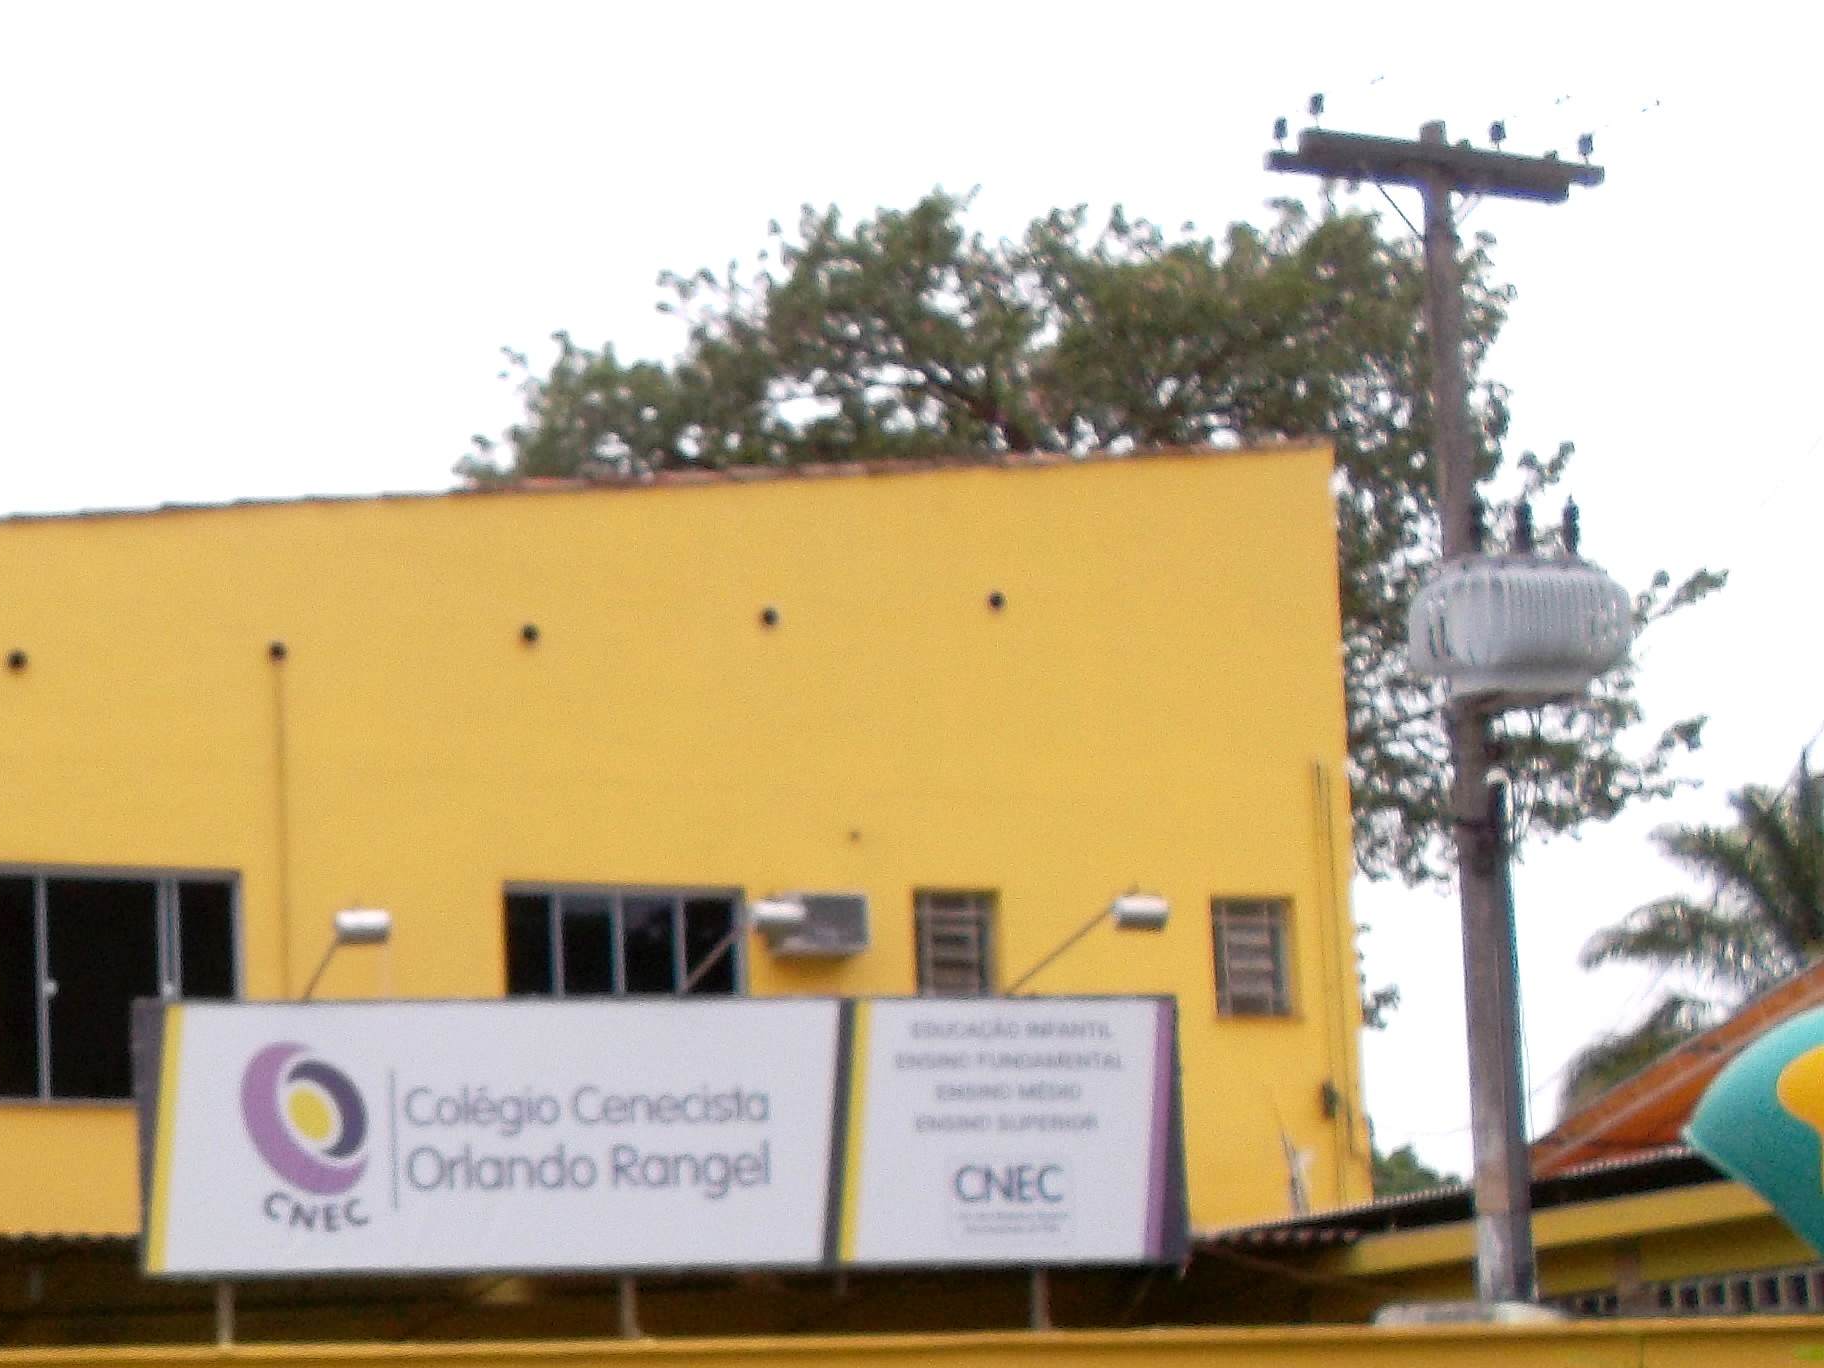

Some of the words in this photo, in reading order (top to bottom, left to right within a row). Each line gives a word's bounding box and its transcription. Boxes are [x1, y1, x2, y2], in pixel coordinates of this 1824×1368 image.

[403, 1084, 562, 1138] Colégio
[570, 1082, 771, 1127] Cenecista
[405, 1141, 600, 1191] Orlando
[609, 1140, 772, 1200] Rangel
[953, 1163, 1064, 1203] CNEC
[262, 1191, 370, 1232] CNEC
